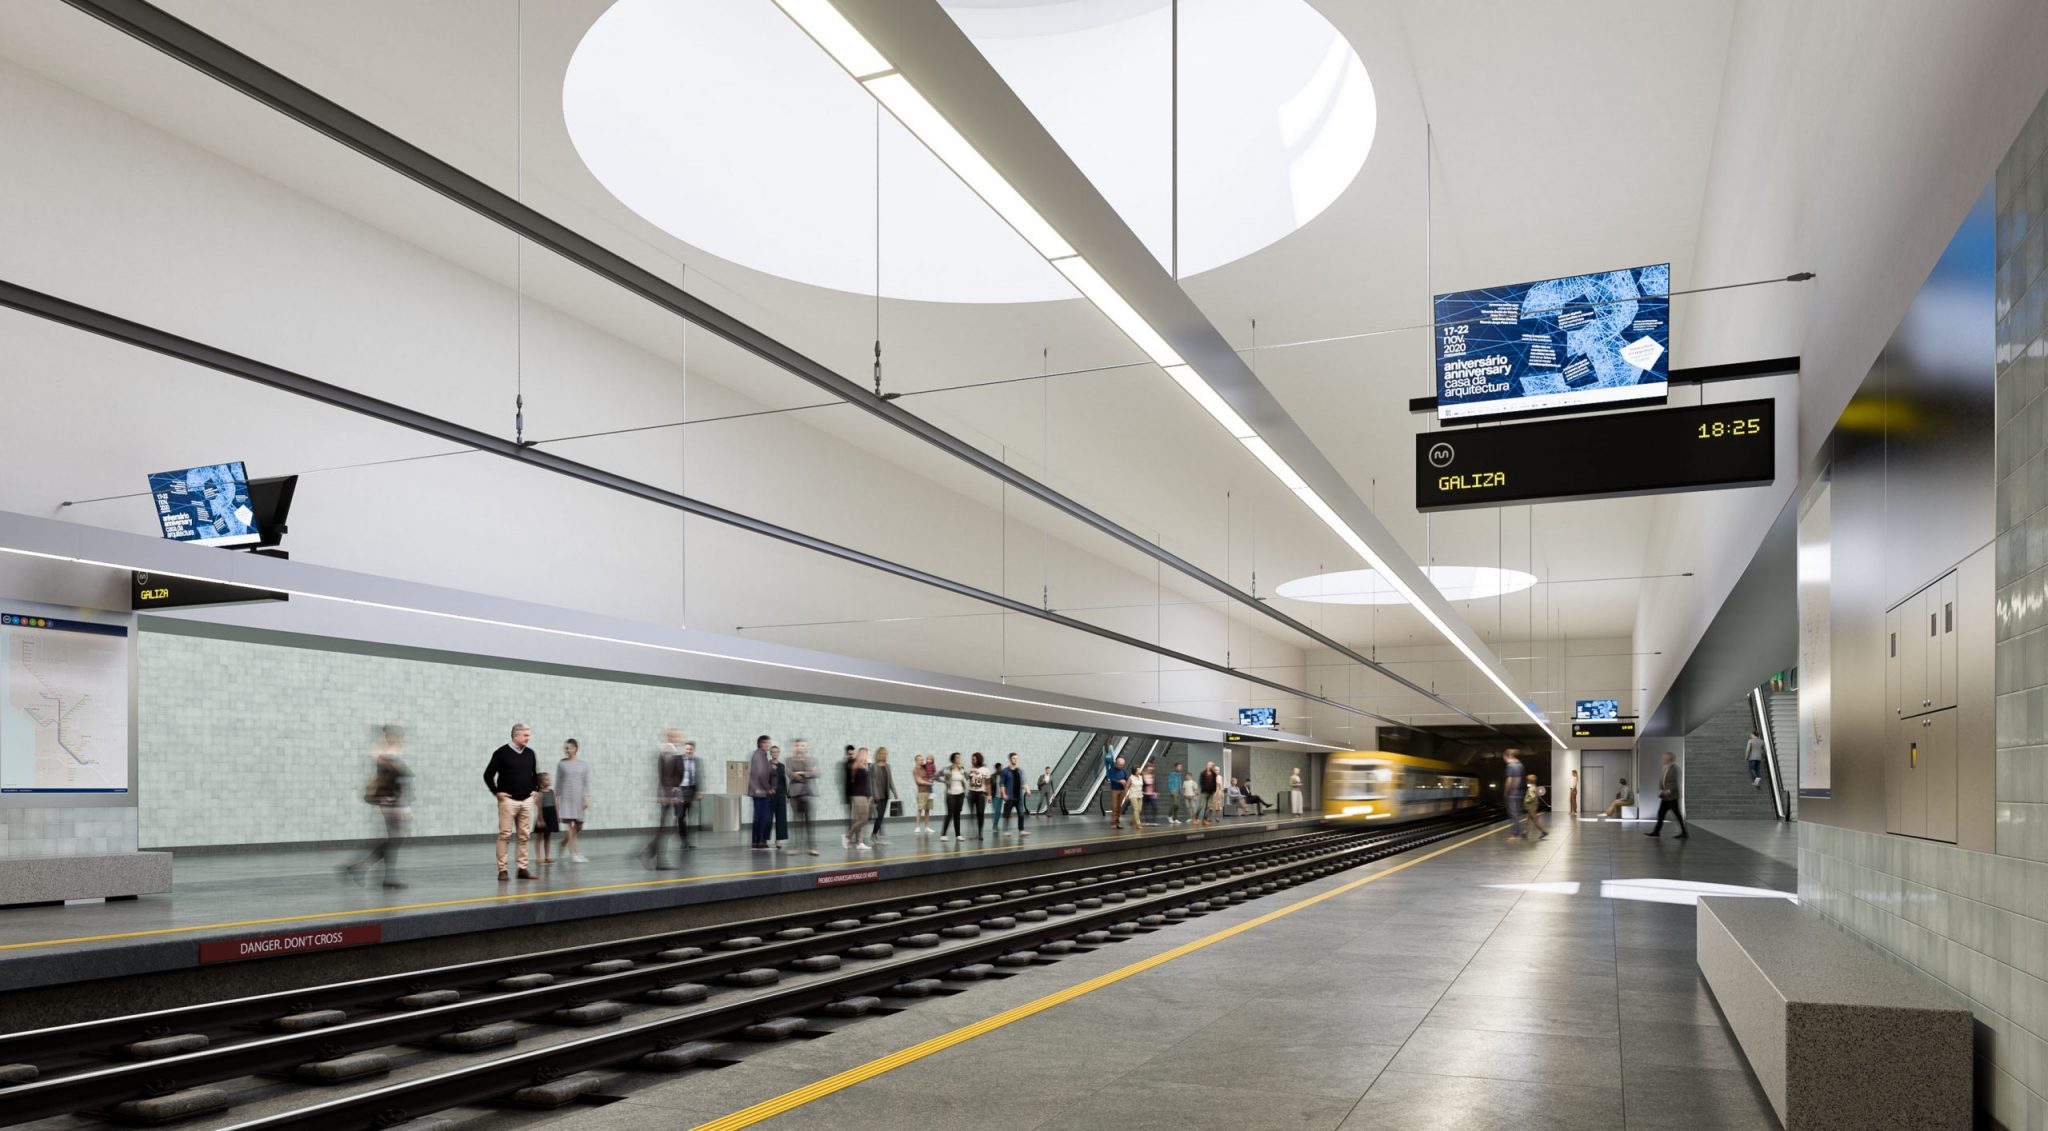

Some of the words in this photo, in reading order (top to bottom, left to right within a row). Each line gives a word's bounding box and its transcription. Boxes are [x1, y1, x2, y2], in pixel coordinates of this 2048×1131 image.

[1443, 325, 1469, 335] 17-22
[1443, 335, 1465, 344] nov.
[1443, 343, 1466, 353] 2020
[1444, 355, 1508, 371] aniversário
[1444, 364, 1512, 380] anniversary
[1444, 377, 1471, 388] casa
[1472, 375, 1486, 385] da
[1444, 382, 1510, 398] arquitectura
[1698, 418, 1760, 439] 18:25
[1438, 471, 1505, 491] GALIZA
[140, 588, 169, 600] GALIZA
[284, 935, 314, 949] DON'T
[314, 932, 343, 945] CROSS
